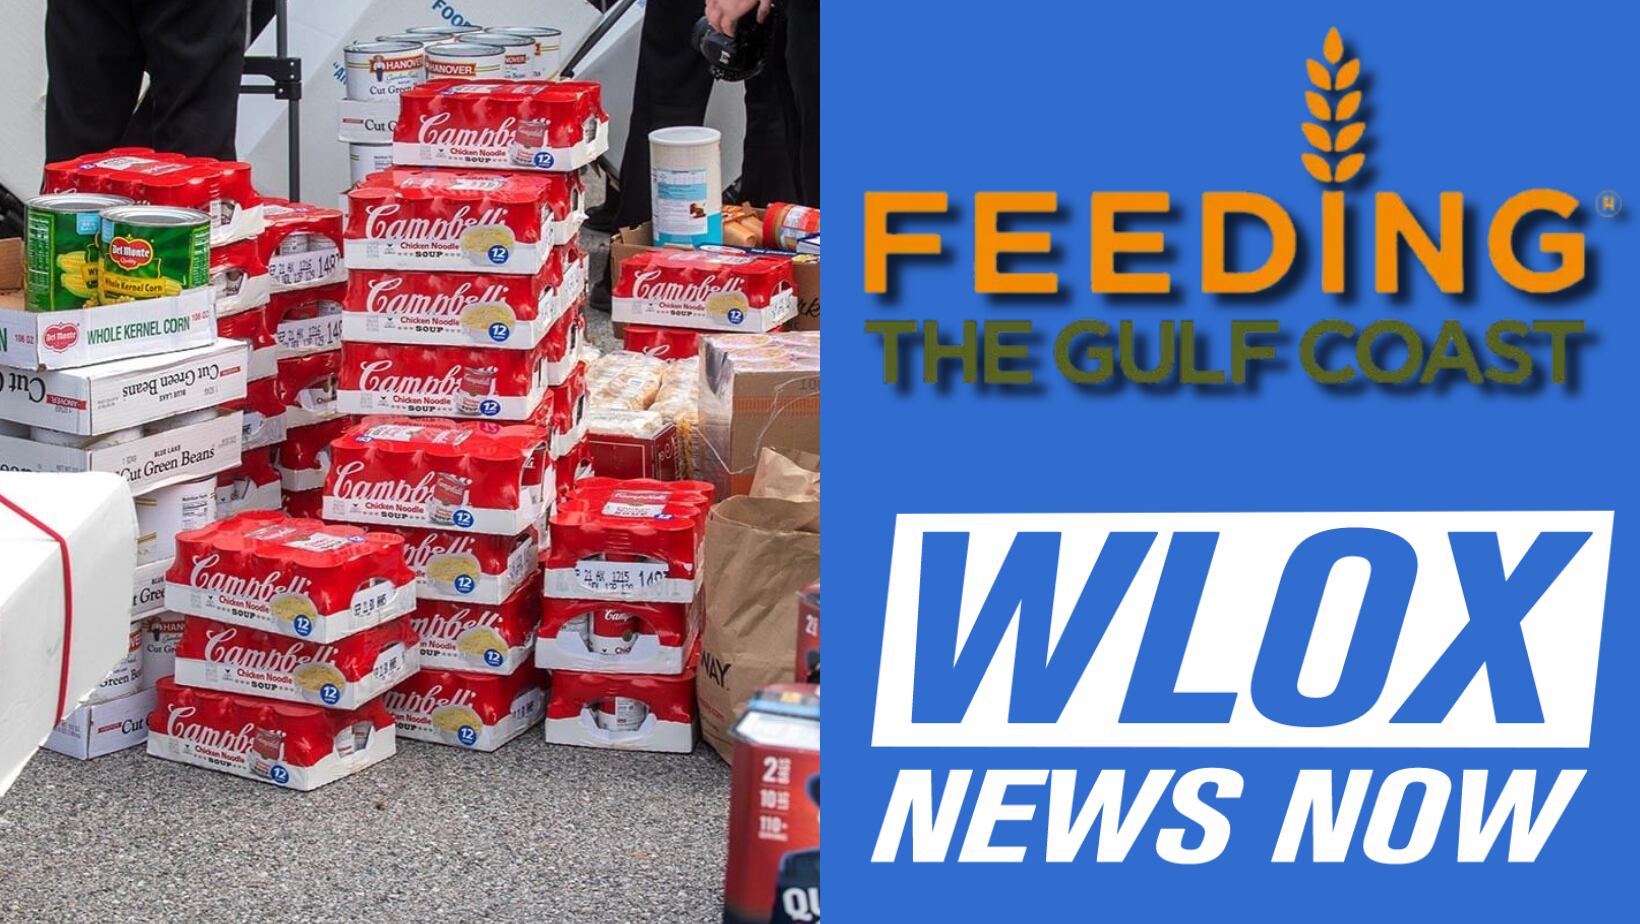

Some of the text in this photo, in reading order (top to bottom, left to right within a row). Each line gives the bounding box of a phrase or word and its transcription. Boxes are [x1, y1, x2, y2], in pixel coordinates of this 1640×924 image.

[431, 64, 472, 75] HANOVER
[369, 85, 386, 95] Cut
[364, 119, 386, 131] Cut
[450, 147, 506, 157] Chicken Noodle
[539, 154, 551, 163] 12
[400, 242, 460, 250] Chicken Noodle
[492, 247, 506, 258] 12
[121, 281, 144, 291] Kernel
[145, 284, 163, 292] Corn
[683, 303, 706, 311] Noodle
[730, 310, 742, 320] 12
[400, 316, 460, 326] Chicken Noodle
[87, 316, 190, 345] WHOLE KERNEL CORN
[492, 325, 507, 336] 12
[198, 364, 220, 380] Cut
[160, 371, 196, 386] Green
[8, 372, 46, 403] Cut
[122, 379, 158, 397] Beans
[393, 395, 451, 405] Chicken Noodle
[483, 401, 498, 411] 12
[144, 457, 178, 477] Green
[181, 447, 215, 466] Beans
[365, 502, 425, 514] Chicken Noodle
[456, 512, 471, 522] 12
[458, 577, 472, 588] 12
[140, 587, 165, 603] Gre
[219, 595, 270, 613] Chicken Noodle
[296, 617, 310, 630] 12
[428, 640, 457, 650] Noodle
[487, 651, 500, 661] 12
[237, 668, 293, 684] Chicken Noodle
[323, 686, 337, 698] 12
[405, 714, 432, 725] Noodle
[122, 718, 143, 734] Cut
[396, 722, 417, 731] OUP
[460, 729, 474, 740] 12
[195, 744, 245, 764] Chicken Noodle
[273, 767, 287, 780] 12
